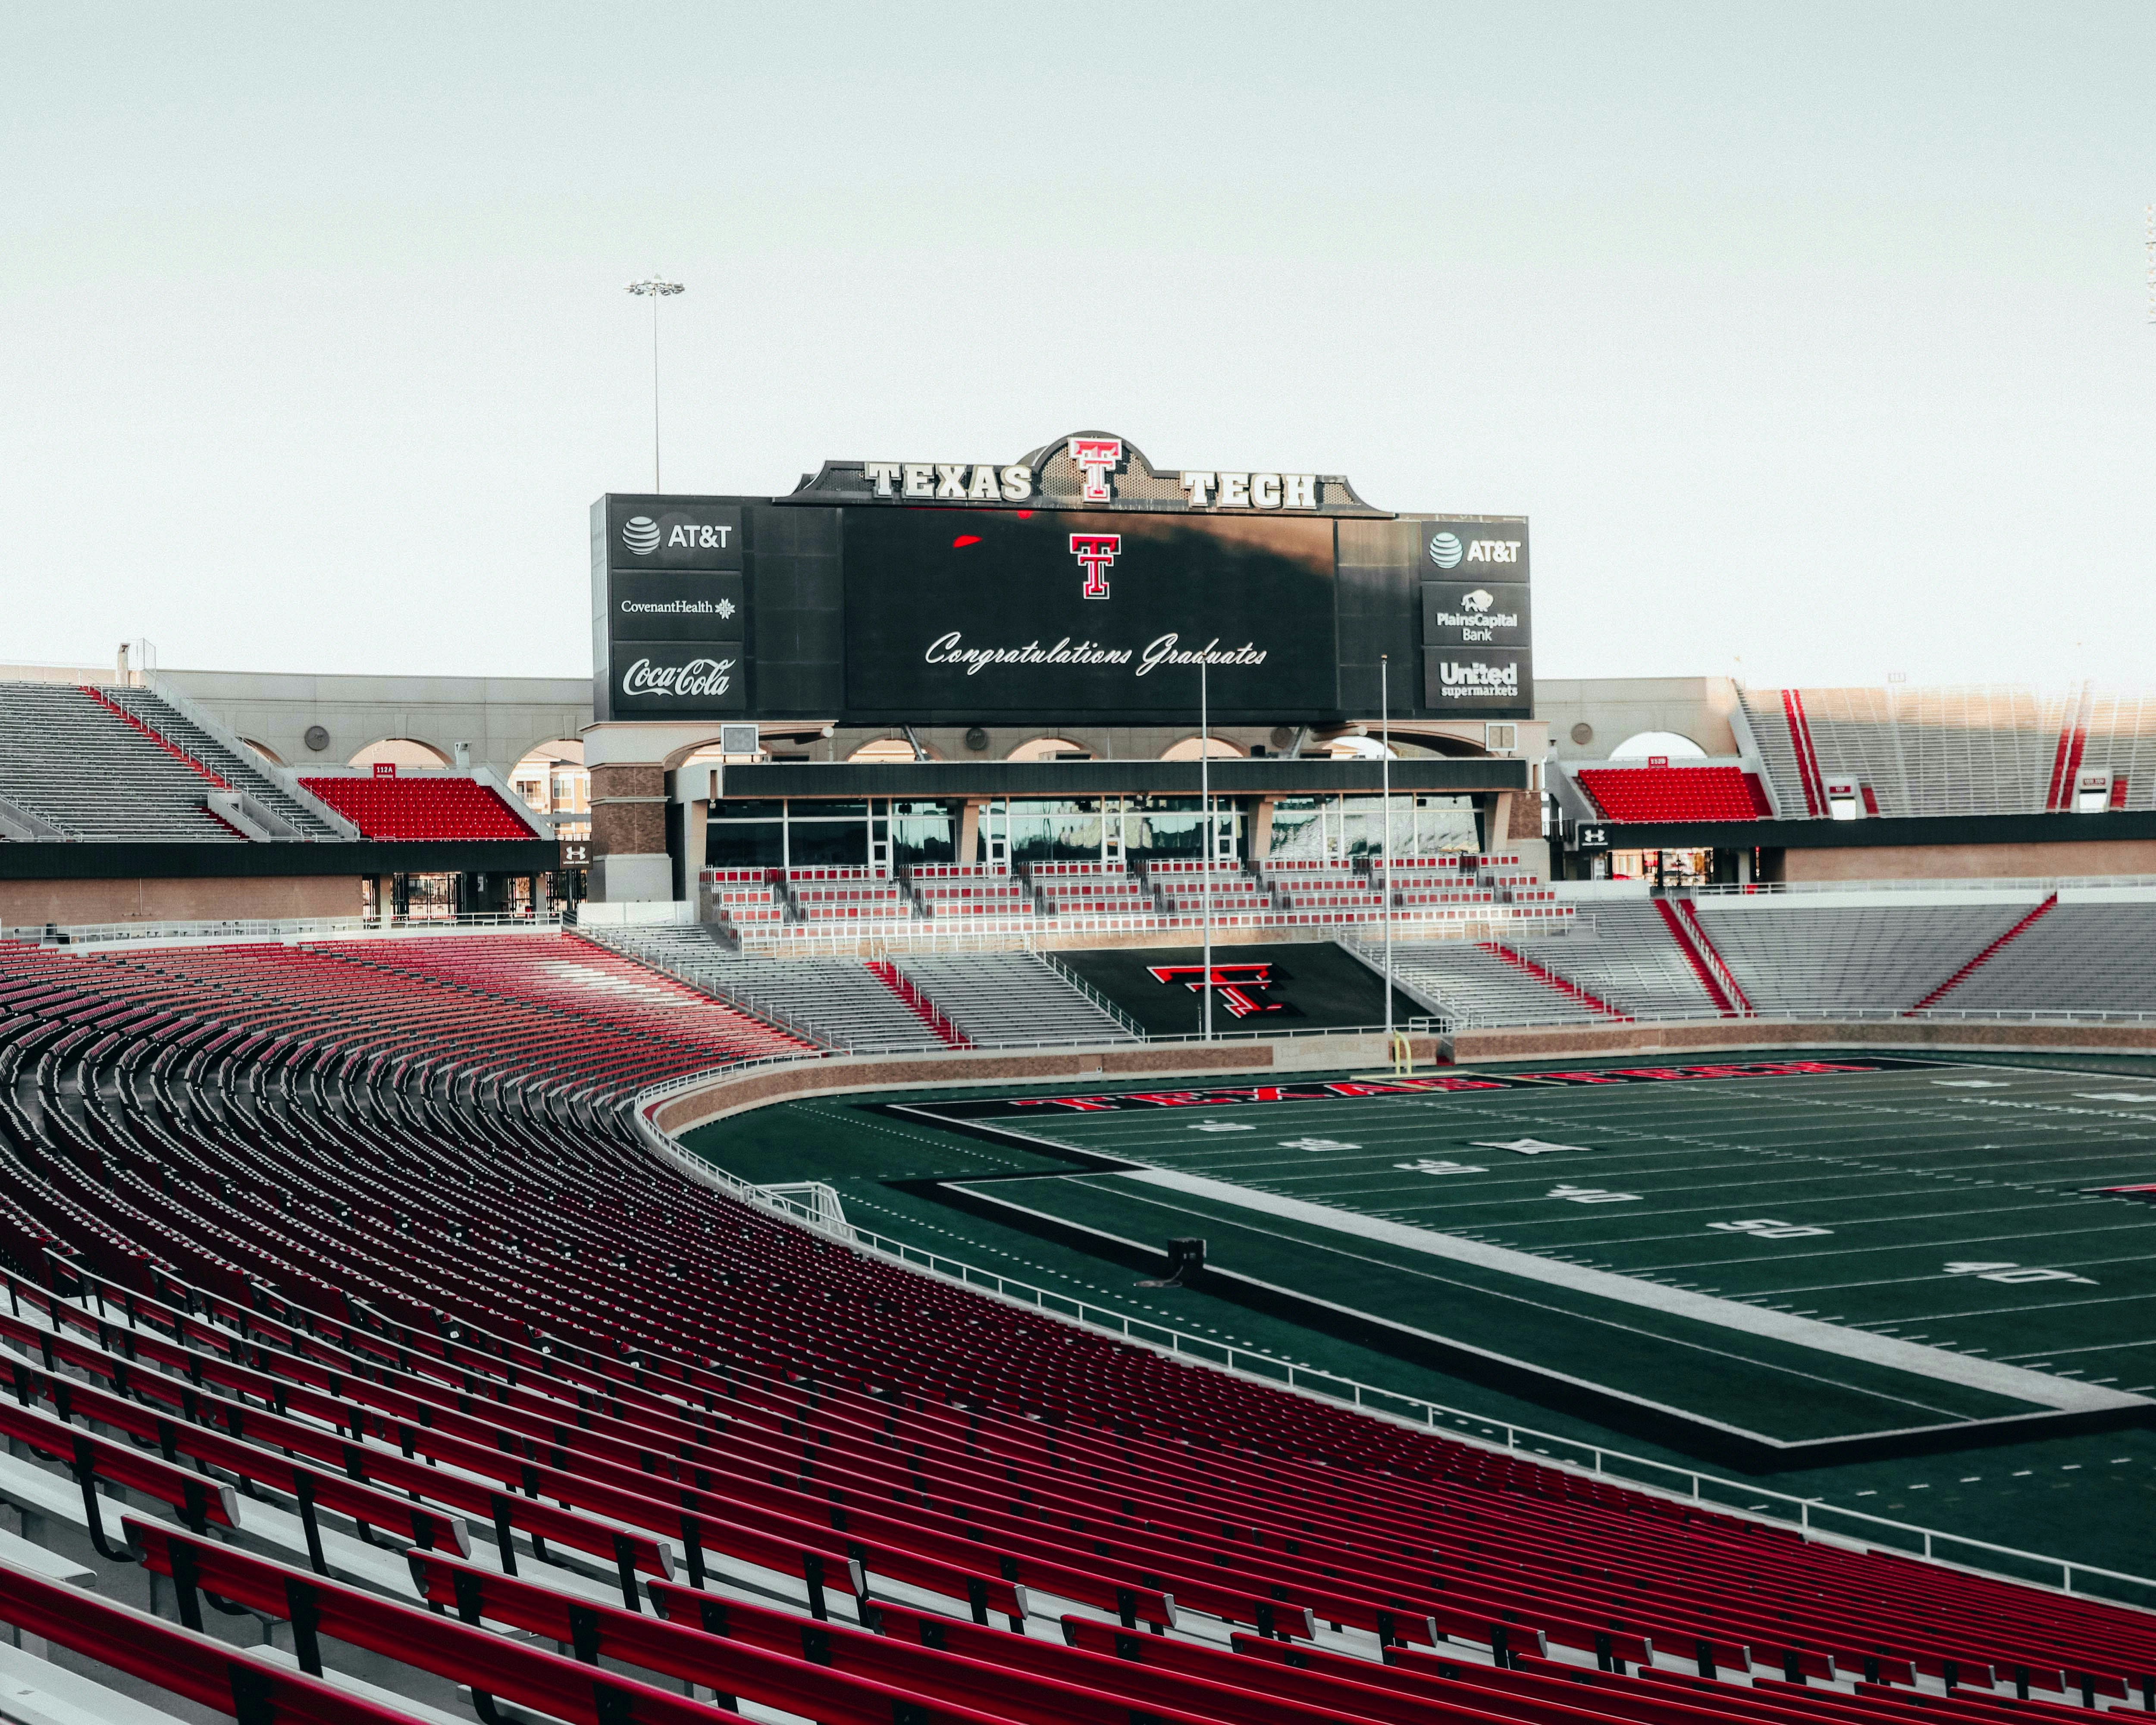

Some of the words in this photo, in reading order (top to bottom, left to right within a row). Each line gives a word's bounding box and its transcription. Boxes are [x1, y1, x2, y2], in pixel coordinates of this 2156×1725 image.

[865, 462, 1032, 502] TEXAS
[1180, 471, 1316, 510] TECH
[667, 525, 732, 548] AT&T
[1467, 540, 1522, 563] AT&T
[1436, 613, 1518, 629] PlainsCapital
[1462, 628, 1492, 641] Bank
[925, 631, 1132, 675] Congratulations
[1135, 633, 1267, 676] Graduates
[623, 659, 736, 696] Coca-Cola
[1439, 662, 1518, 685] United
[1441, 686, 1518, 699] supermarkets
[1008, 1078, 1512, 1111] TEXAS
